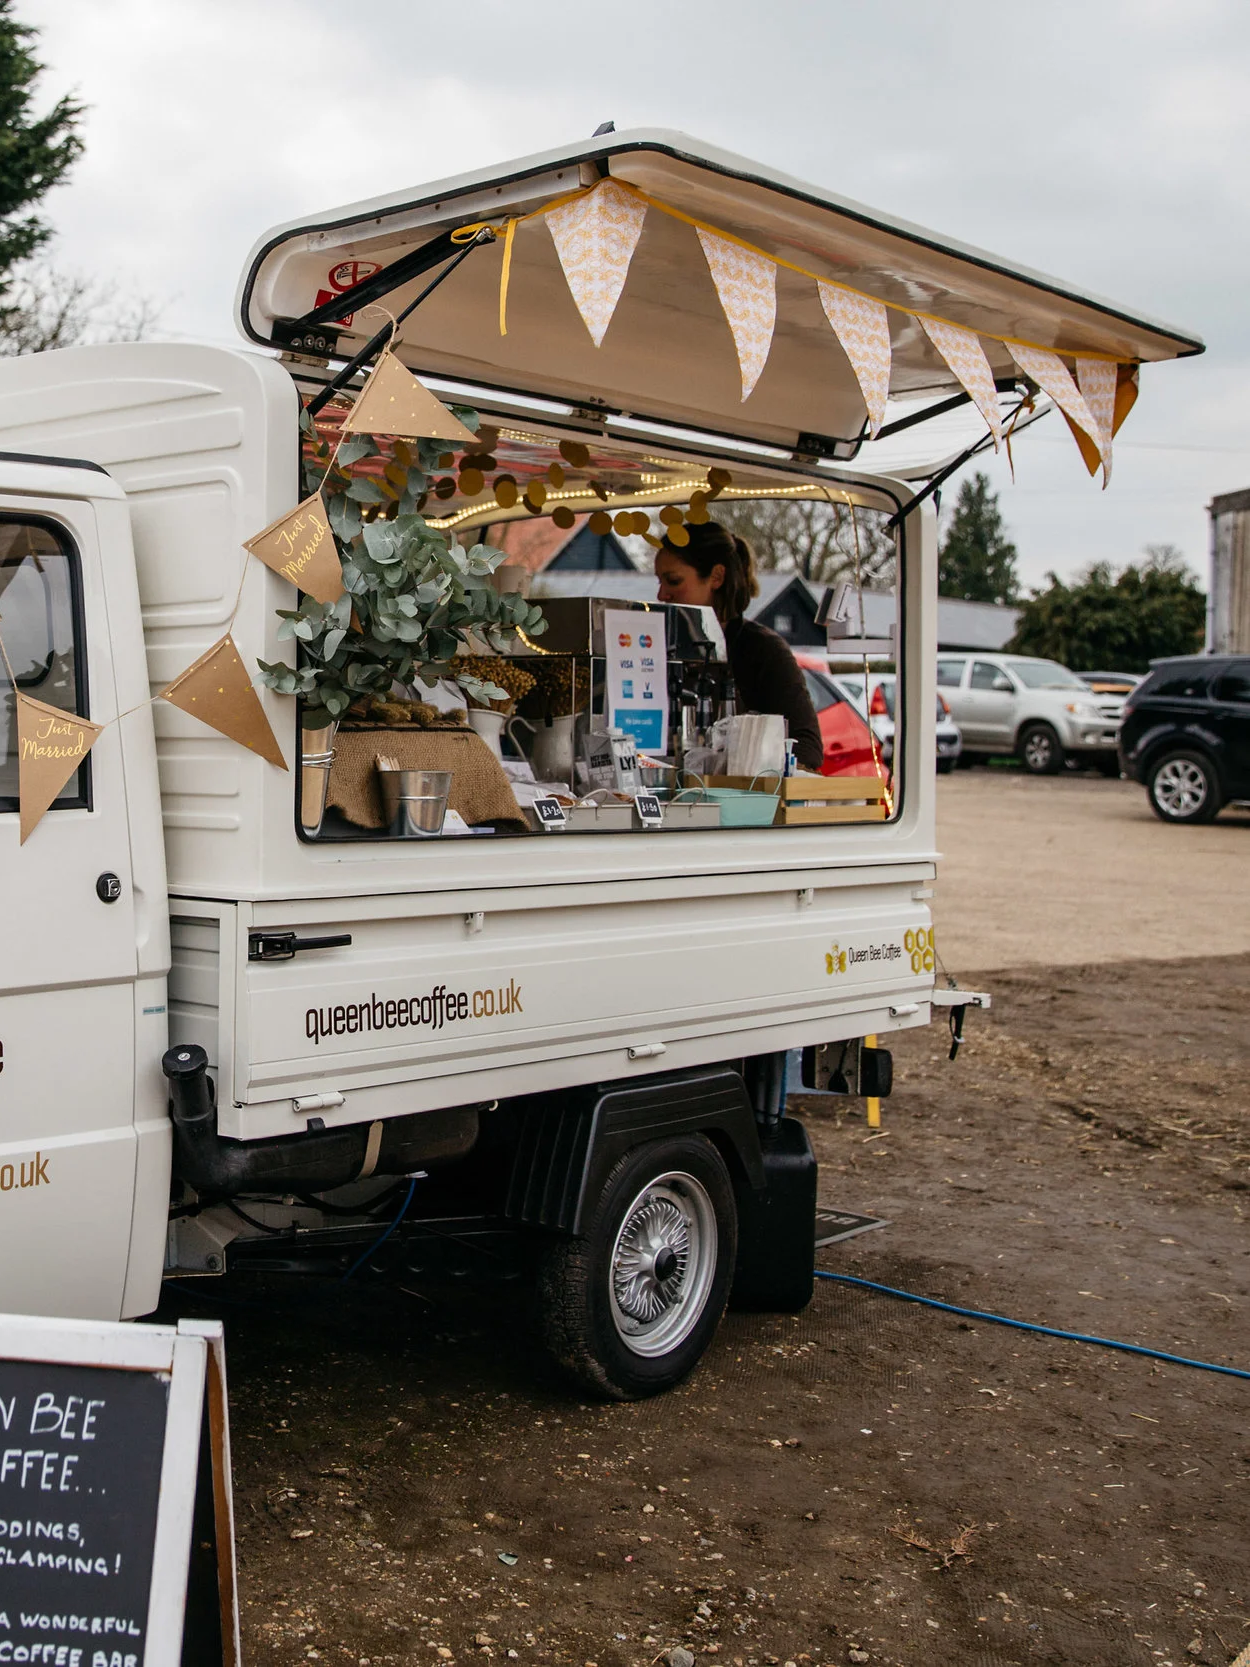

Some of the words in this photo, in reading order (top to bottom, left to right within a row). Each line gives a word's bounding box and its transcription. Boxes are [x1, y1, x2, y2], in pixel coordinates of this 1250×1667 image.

[275, 514, 307, 557] Just
[279, 514, 329, 584] Married
[36, 718, 78, 739] Just
[21, 731, 88, 760] Married
[619, 755, 636, 770] LY!
[848, 946, 868, 964] Queen
[869, 945, 881, 961] Bee
[881, 943, 901, 961] Coffee
[305, 978, 523, 1044] queenbeecoffee.co.uk
[30, 1393, 106, 1441] BEE
[20, 1612, 141, 1637] WONDERFUL
[92, 1651, 137, 1667] BAR
